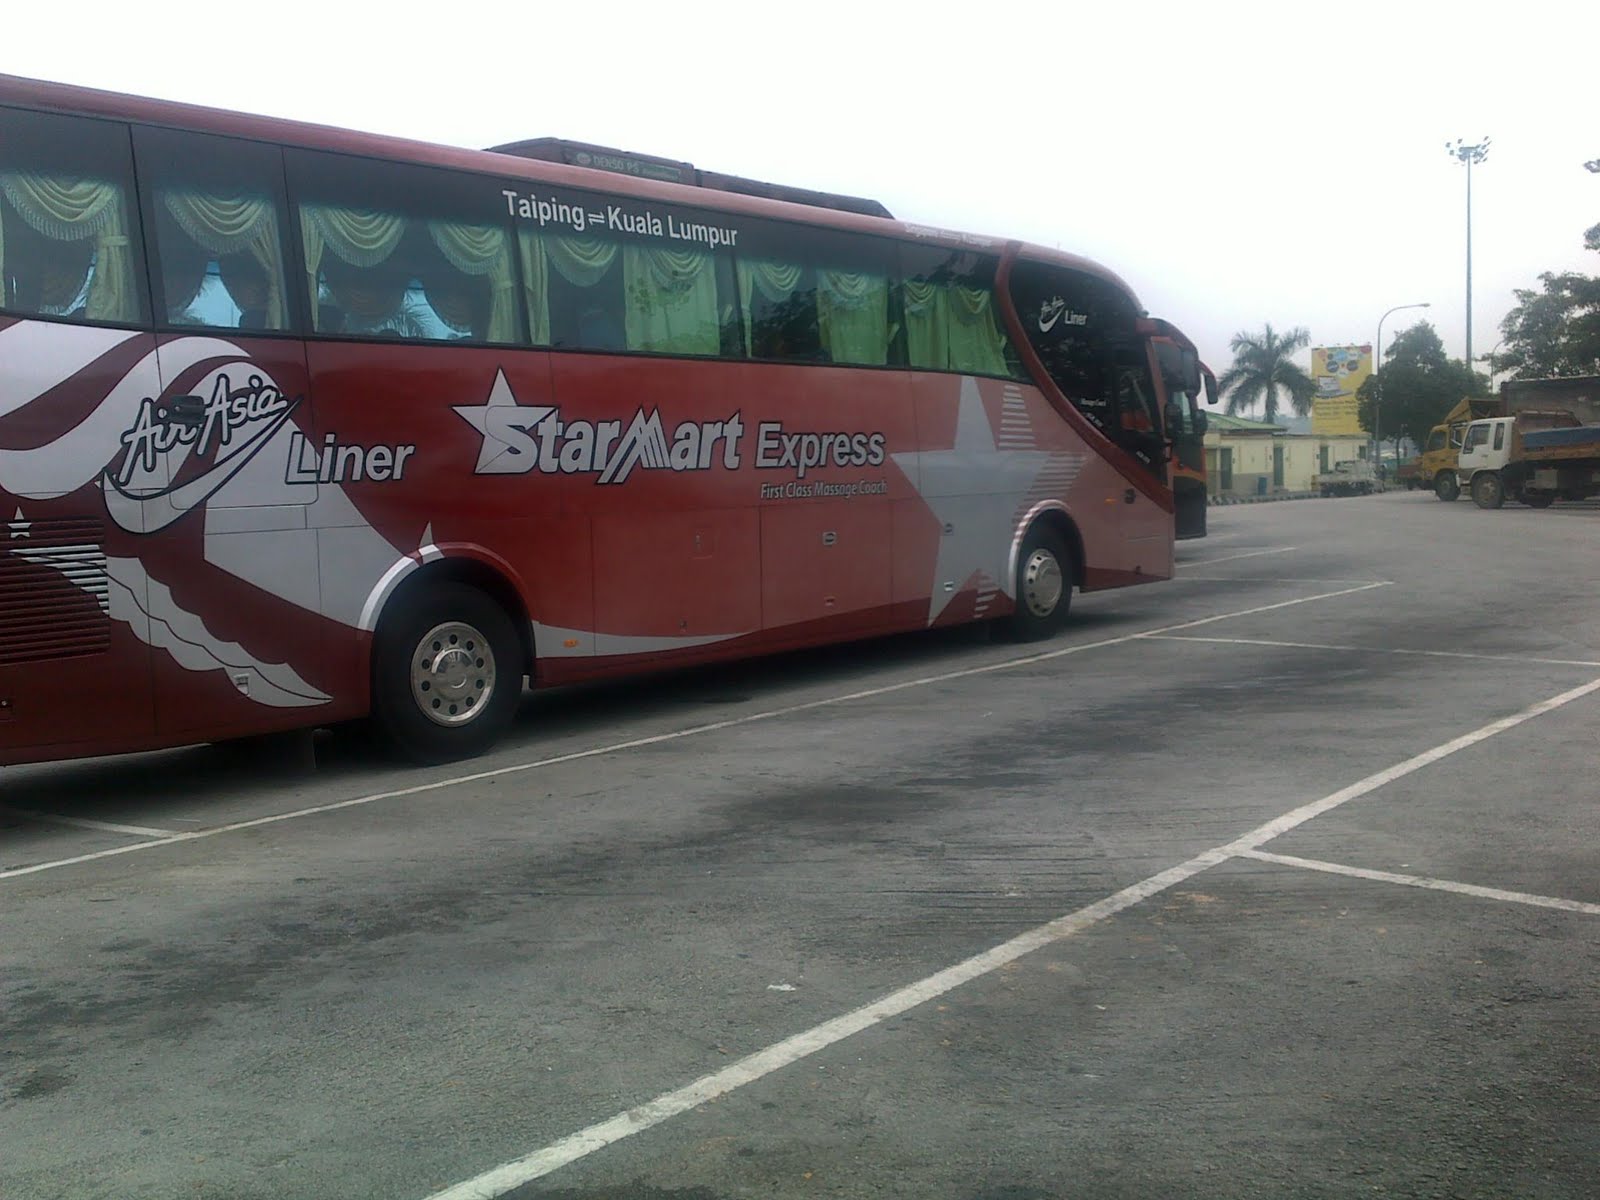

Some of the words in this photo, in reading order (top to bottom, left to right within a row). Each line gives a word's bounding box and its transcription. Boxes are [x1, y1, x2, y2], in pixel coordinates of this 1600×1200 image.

[502, 190, 585, 231] Taiping
[607, 205, 663, 236] Kuala
[667, 215, 738, 248] Lumpur
[1065, 310, 1087, 325] Liner
[285, 431, 415, 484] Liner
[755, 421, 885, 478] Express
[761, 483, 783, 499] First
[785, 482, 812, 497] Class
[814, 482, 857, 498] Massage
[859, 479, 887, 494] Coach
